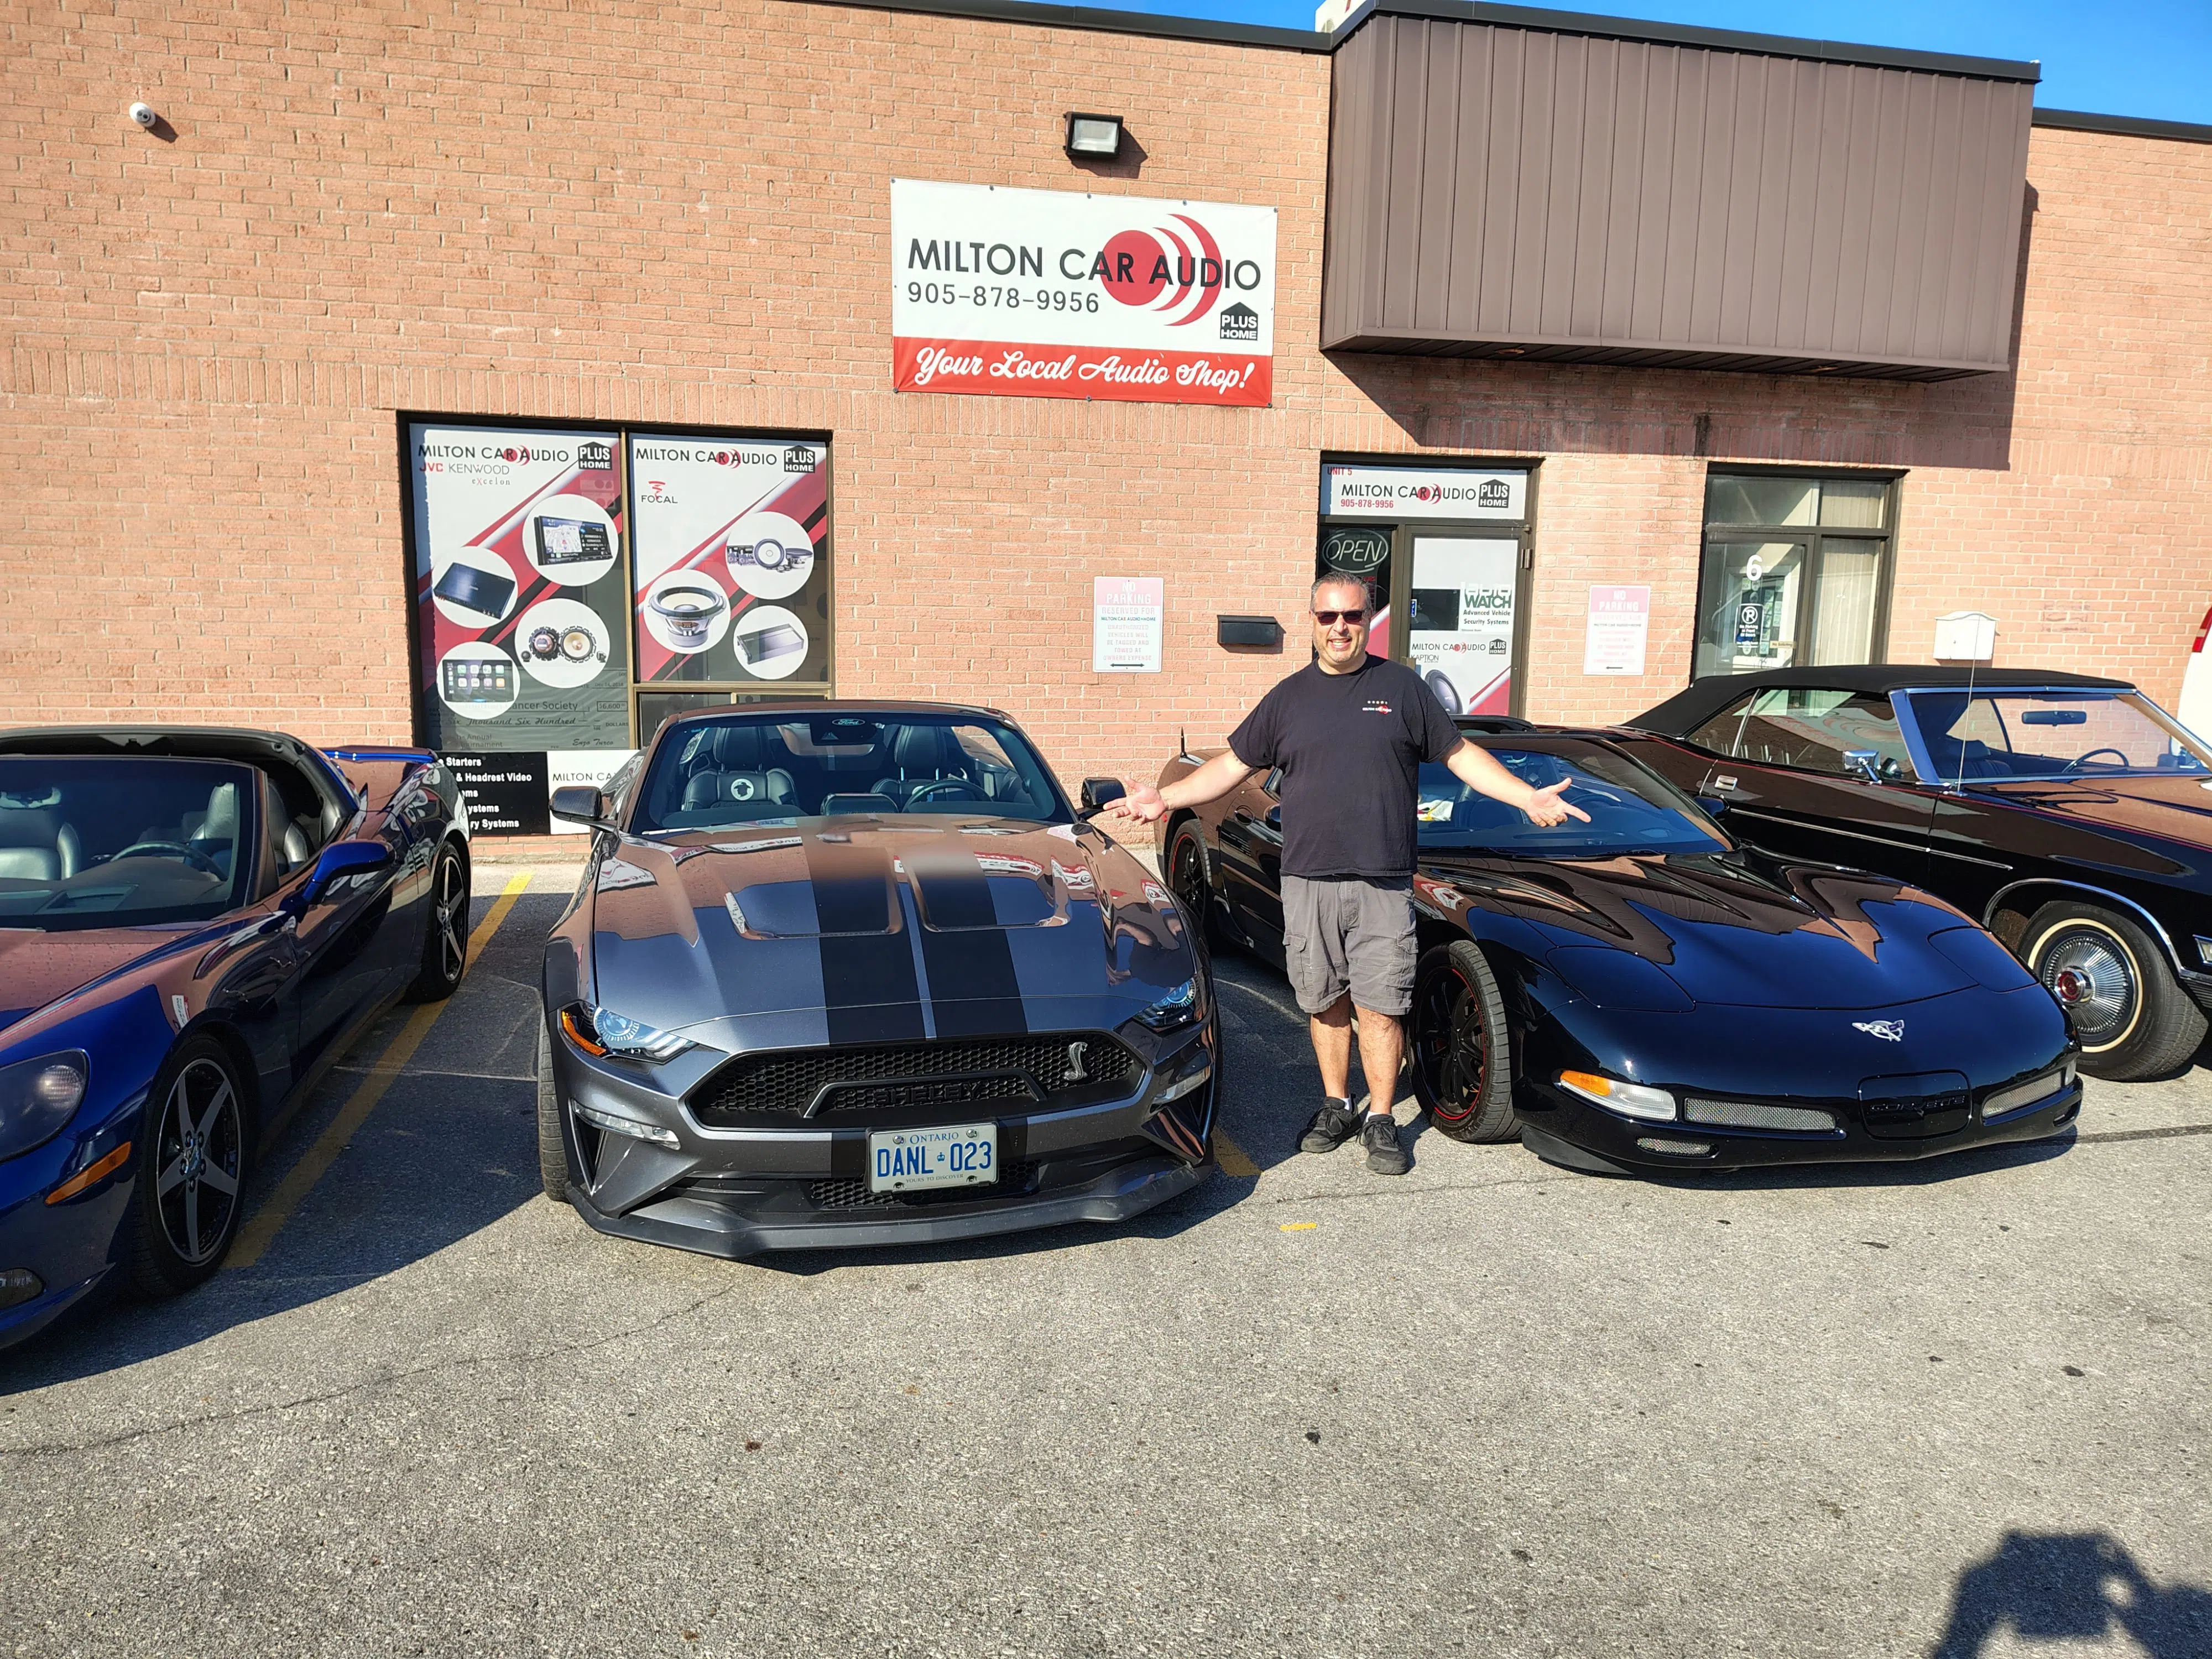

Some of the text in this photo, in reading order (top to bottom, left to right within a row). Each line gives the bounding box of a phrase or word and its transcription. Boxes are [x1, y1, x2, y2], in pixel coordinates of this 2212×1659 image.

[907, 238, 1261, 291] MILTON CAR AUDIO
[907, 282, 1100, 313] 905-878-9956
[1221, 314, 1258, 329] PLUS
[1220, 330, 1258, 340] HOME
[915, 346, 1255, 395] Your Local Audio Shop!
[418, 444, 570, 462] MILTON CAR AUDIO
[579, 447, 611, 461] PLUS
[635, 448, 778, 466] MILTON CAR AUDIO
[785, 450, 814, 464] PLUS
[419, 462, 510, 475] JVC KENWOOD
[580, 461, 611, 469] HOME
[785, 464, 814, 472] HOME
[1327, 467, 1345, 475] UNIT
[1341, 484, 1477, 500] MILTON CAR AUDIO
[1480, 484, 1509, 497] PLUS
[641, 494, 679, 504] FOCAL
[1340, 499, 1394, 508] 905-878-9956
[1480, 499, 1507, 507] HOME
[1326, 540, 1383, 562] OPEN
[1746, 554, 1763, 581] 6
[1122, 582, 1136, 593] NO
[1107, 593, 1151, 604] PARKING
[1613, 590, 1626, 601] NO
[1464, 594, 1511, 609] WATCH
[1599, 601, 1639, 612] PARKING
[1411, 643, 1440, 651] MILTON
[510, 701, 578, 711] ancer Society
[572, 738, 591, 747] Enzo
[446, 757, 482, 766] Starters
[456, 773, 533, 782] & Headrest Video
[552, 773, 615, 781] MILTON CA
[467, 804, 500, 815] ystems
[482, 818, 520, 830] Systems
[873, 1082, 980, 1105] SHELBY
[909, 1132, 959, 1144] ONTARIO
[877, 1141, 992, 1177] DANL 023
